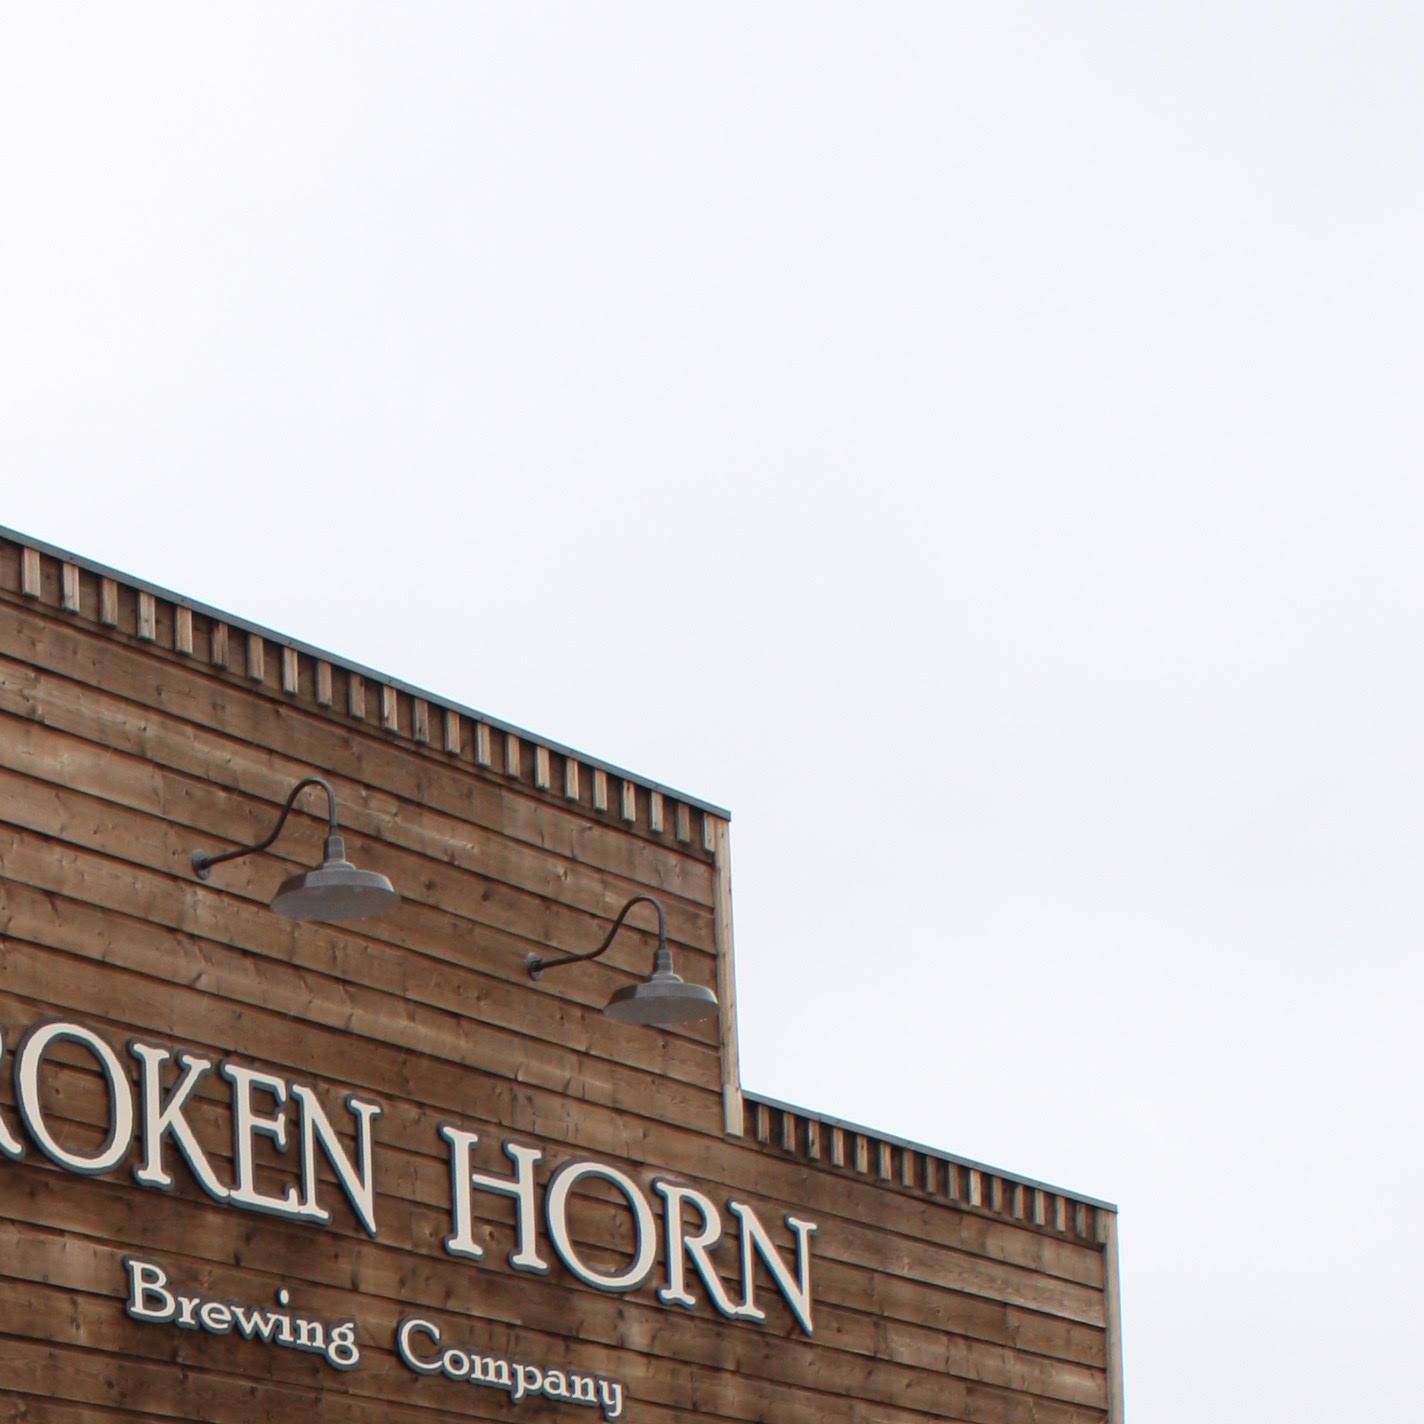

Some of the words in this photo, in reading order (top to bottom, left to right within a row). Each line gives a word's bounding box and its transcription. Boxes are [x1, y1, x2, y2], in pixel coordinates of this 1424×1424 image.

[439, 1123, 818, 1335] HORN
[126, 1257, 360, 1369] Brewing
[397, 1317, 626, 1419] Company
